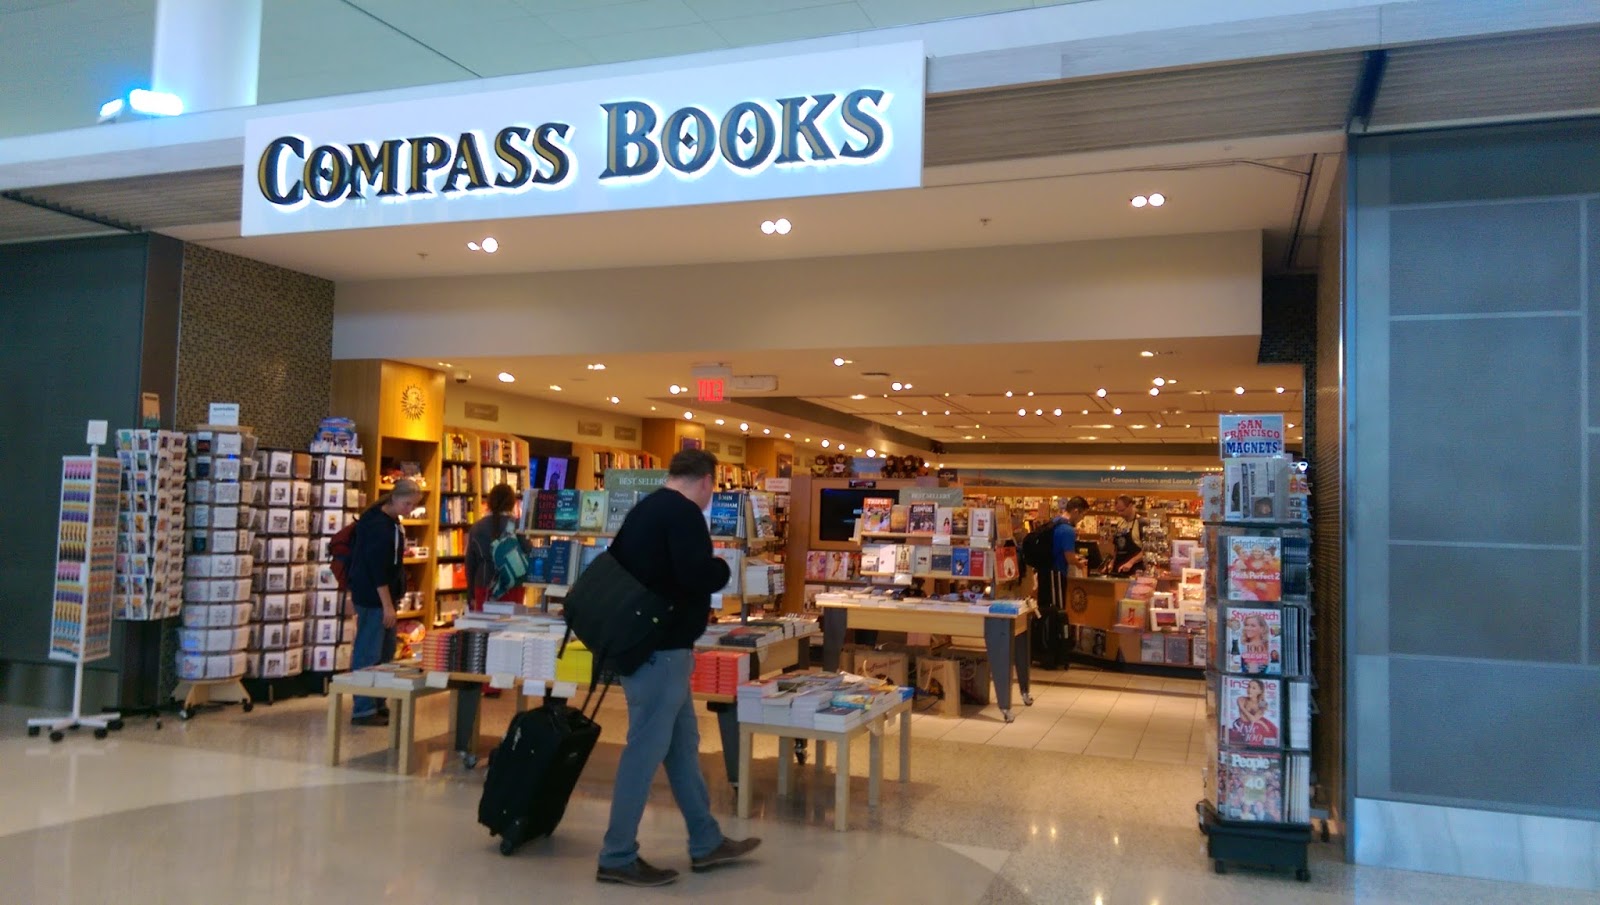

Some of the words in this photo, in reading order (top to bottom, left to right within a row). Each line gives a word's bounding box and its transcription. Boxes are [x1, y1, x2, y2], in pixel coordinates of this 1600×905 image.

[258, 121, 571, 206] COMPASS
[599, 88, 886, 180] BOOKS
[1239, 419, 1263, 430] SAN
[1223, 428, 1281, 440] FRANCISCO
[1226, 441, 1279, 454] MAGNETS
[619, 477, 636, 486] BEST
[638, 477, 667, 486] SELLERS
[1112, 476, 1138, 485] Compass
[1173, 477, 1193, 486] Lonely
[1249, 571, 1274, 580] Perfect
[1275, 572, 1281, 580] 2
[1230, 679, 1277, 691] InSle
[1231, 753, 1271, 770] People
